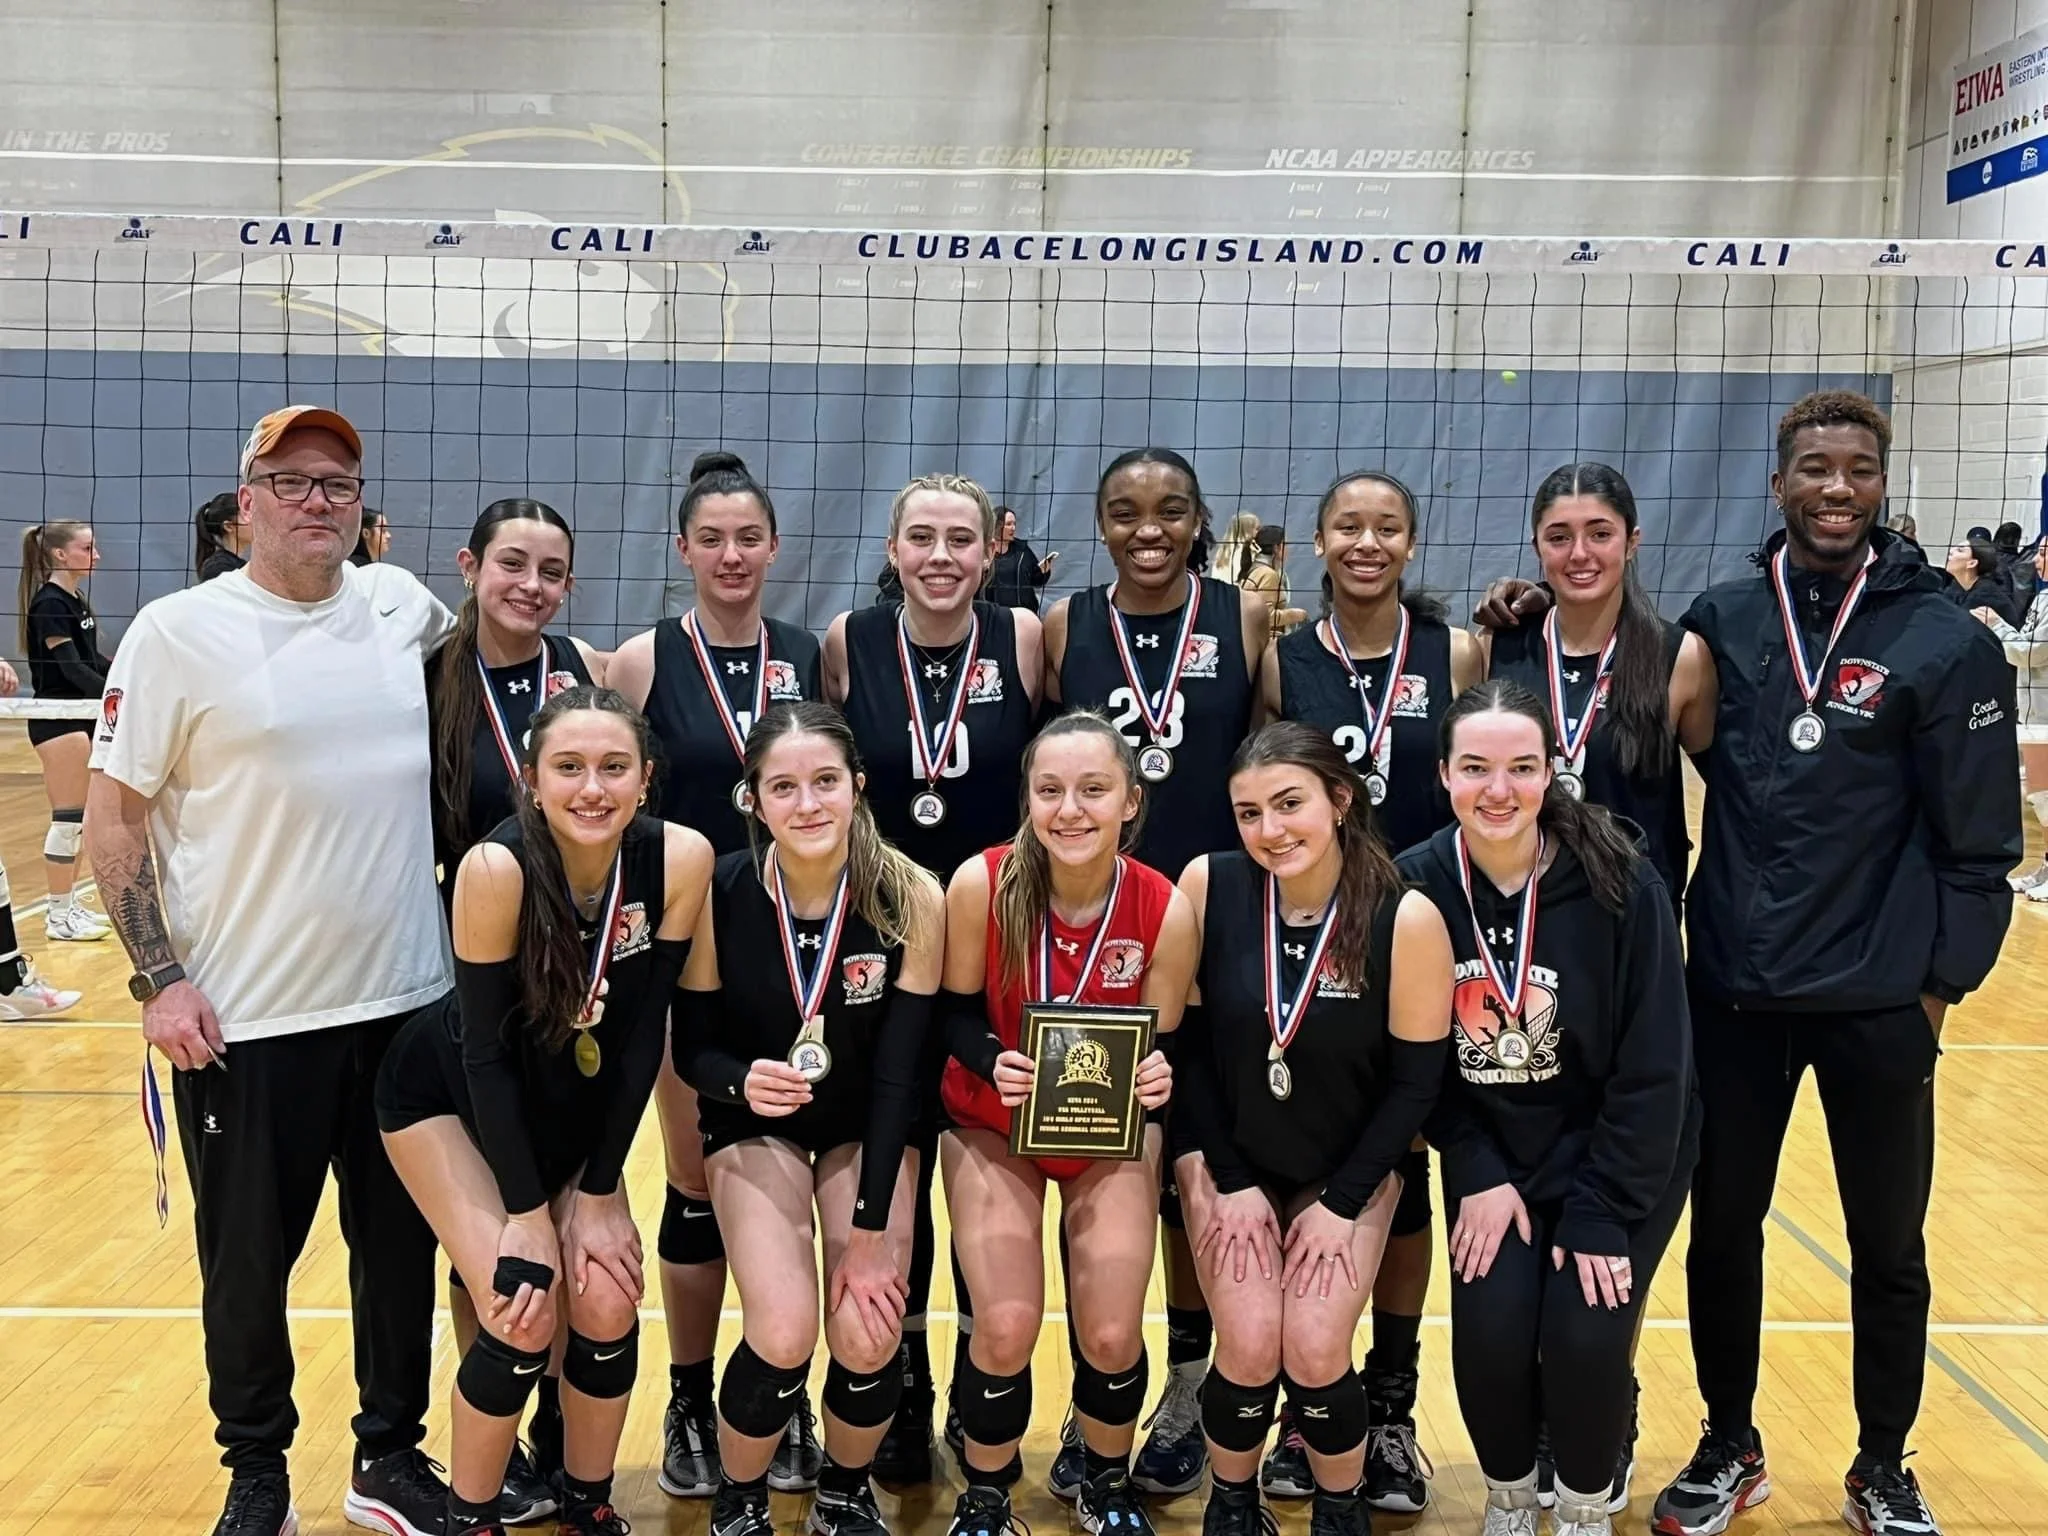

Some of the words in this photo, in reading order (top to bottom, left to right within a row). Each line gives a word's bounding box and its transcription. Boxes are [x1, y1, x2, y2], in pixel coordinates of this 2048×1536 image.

[2009, 54, 2036, 75] EASTERN
[2009, 63, 2046, 88] WRESTLING
[1955, 62, 2004, 116] EIWA
[2, 129, 33, 150] IN
[44, 131, 95, 151] THE
[100, 131, 172, 153] PROS
[801, 143, 969, 166] CONFERENCE
[976, 145, 1194, 169] CHAMPIONSHIPS
[1265, 148, 1340, 169] NCAA
[1344, 149, 1536, 170] APPEARANCES
[240, 221, 343, 247] CALI
[551, 226, 653, 253] CALI
[858, 233, 1484, 265] CLUBACELONGISLAND.COM
[1687, 242, 1790, 266] CALI
[1995, 244, 2048, 269] CA
[1972, 697, 1999, 716] Coach
[1968, 710, 2005, 730] Graham
